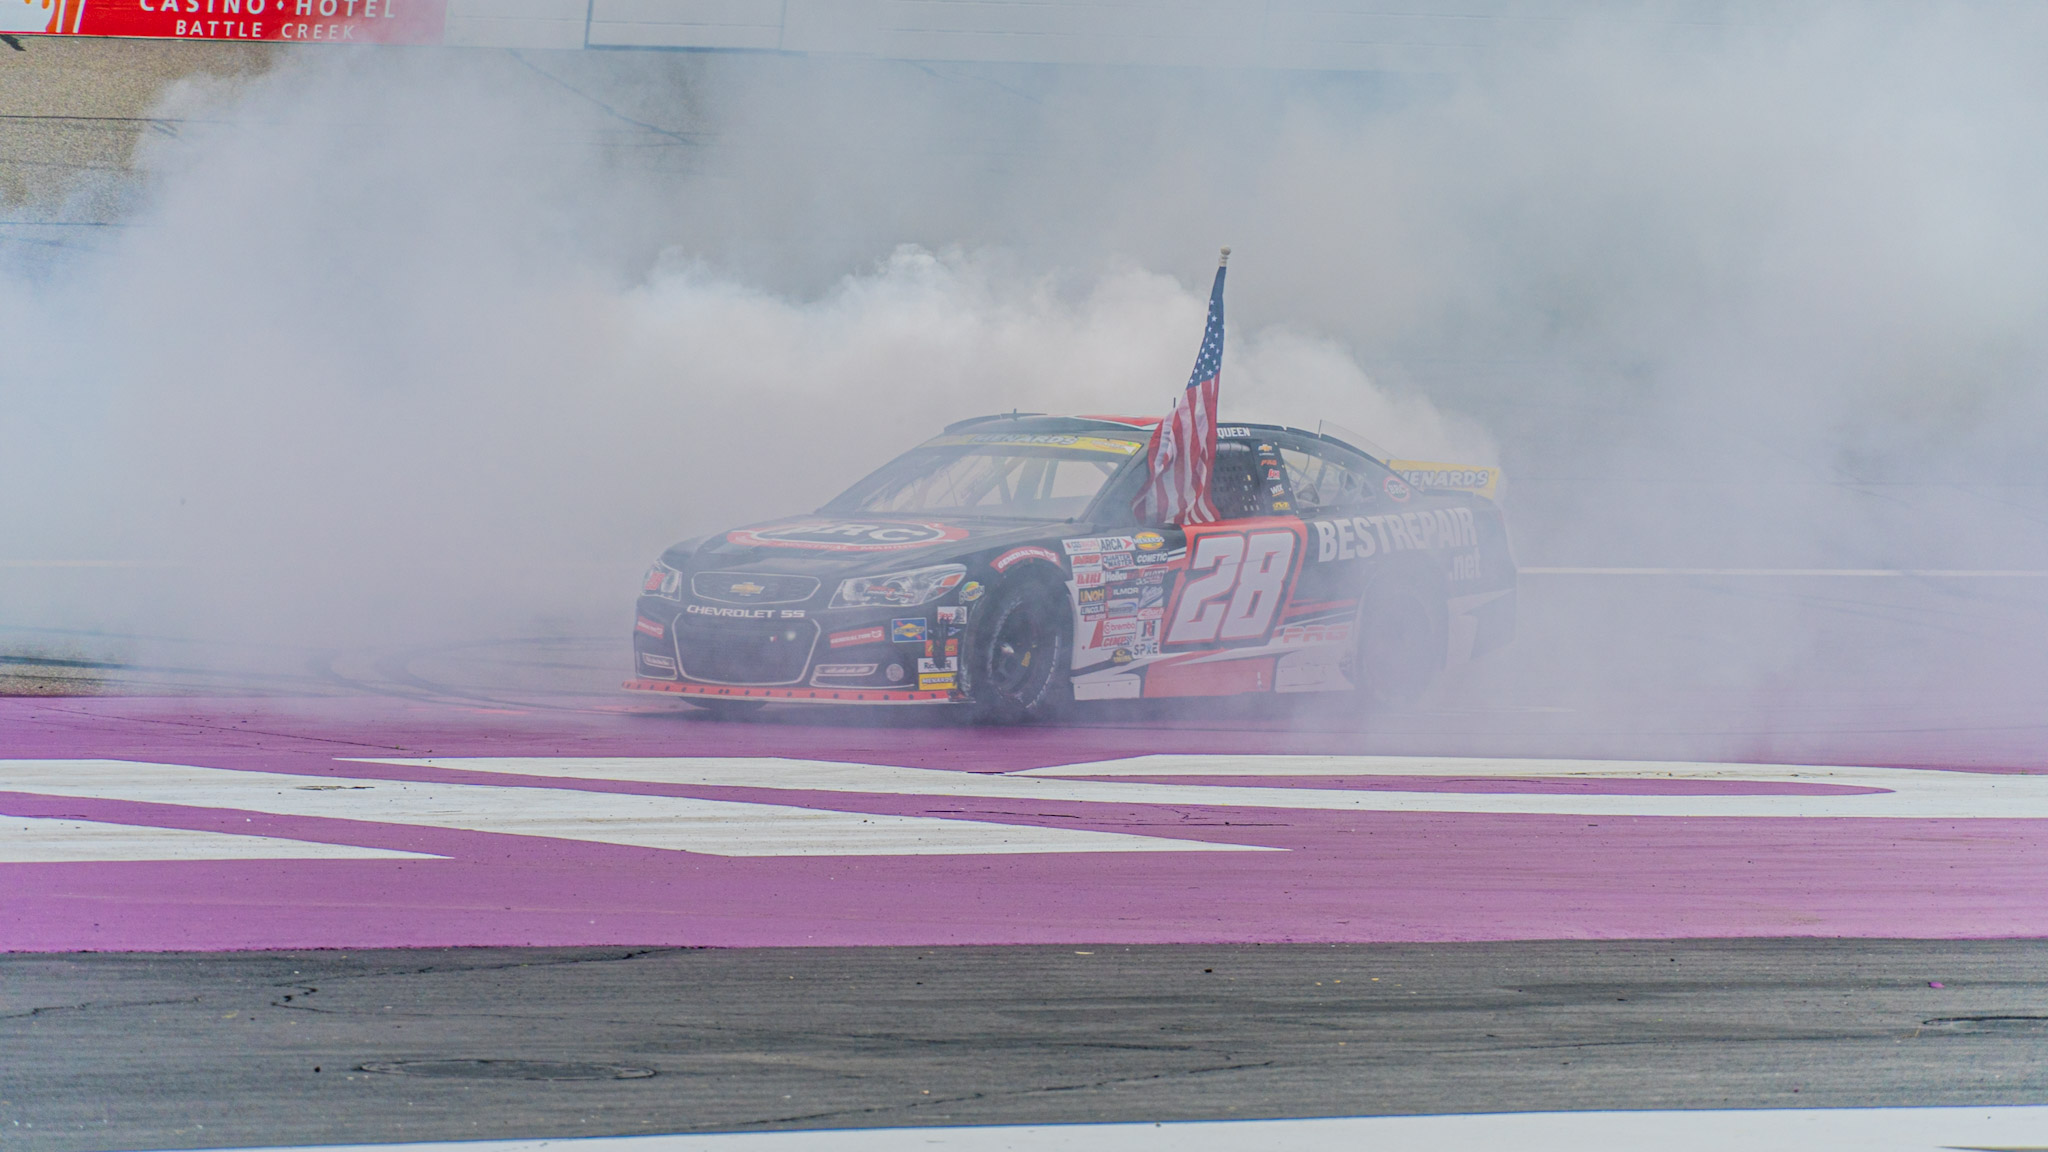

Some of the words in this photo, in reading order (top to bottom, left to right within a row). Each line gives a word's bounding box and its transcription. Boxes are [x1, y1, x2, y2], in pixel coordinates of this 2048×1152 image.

[140, 0, 265, 14] CASINO
[295, 0, 395, 18] HOTEL
[175, 20, 263, 38] BATTLE
[281, 23, 355, 40] CREEK
[1216, 427, 1251, 439] QUEEN
[1314, 507, 1479, 563] BESTREPAIR
[1101, 539, 1123, 552] ARCA
[1136, 552, 1168, 563] COMETIC
[1450, 549, 1482, 582] .net
[1166, 532, 1294, 643] 28
[1081, 589, 1105, 602] UNOH
[686, 605, 776, 618] CHEVROLET
[781, 609, 806, 618] SS
[1111, 622, 1136, 631] brembo
